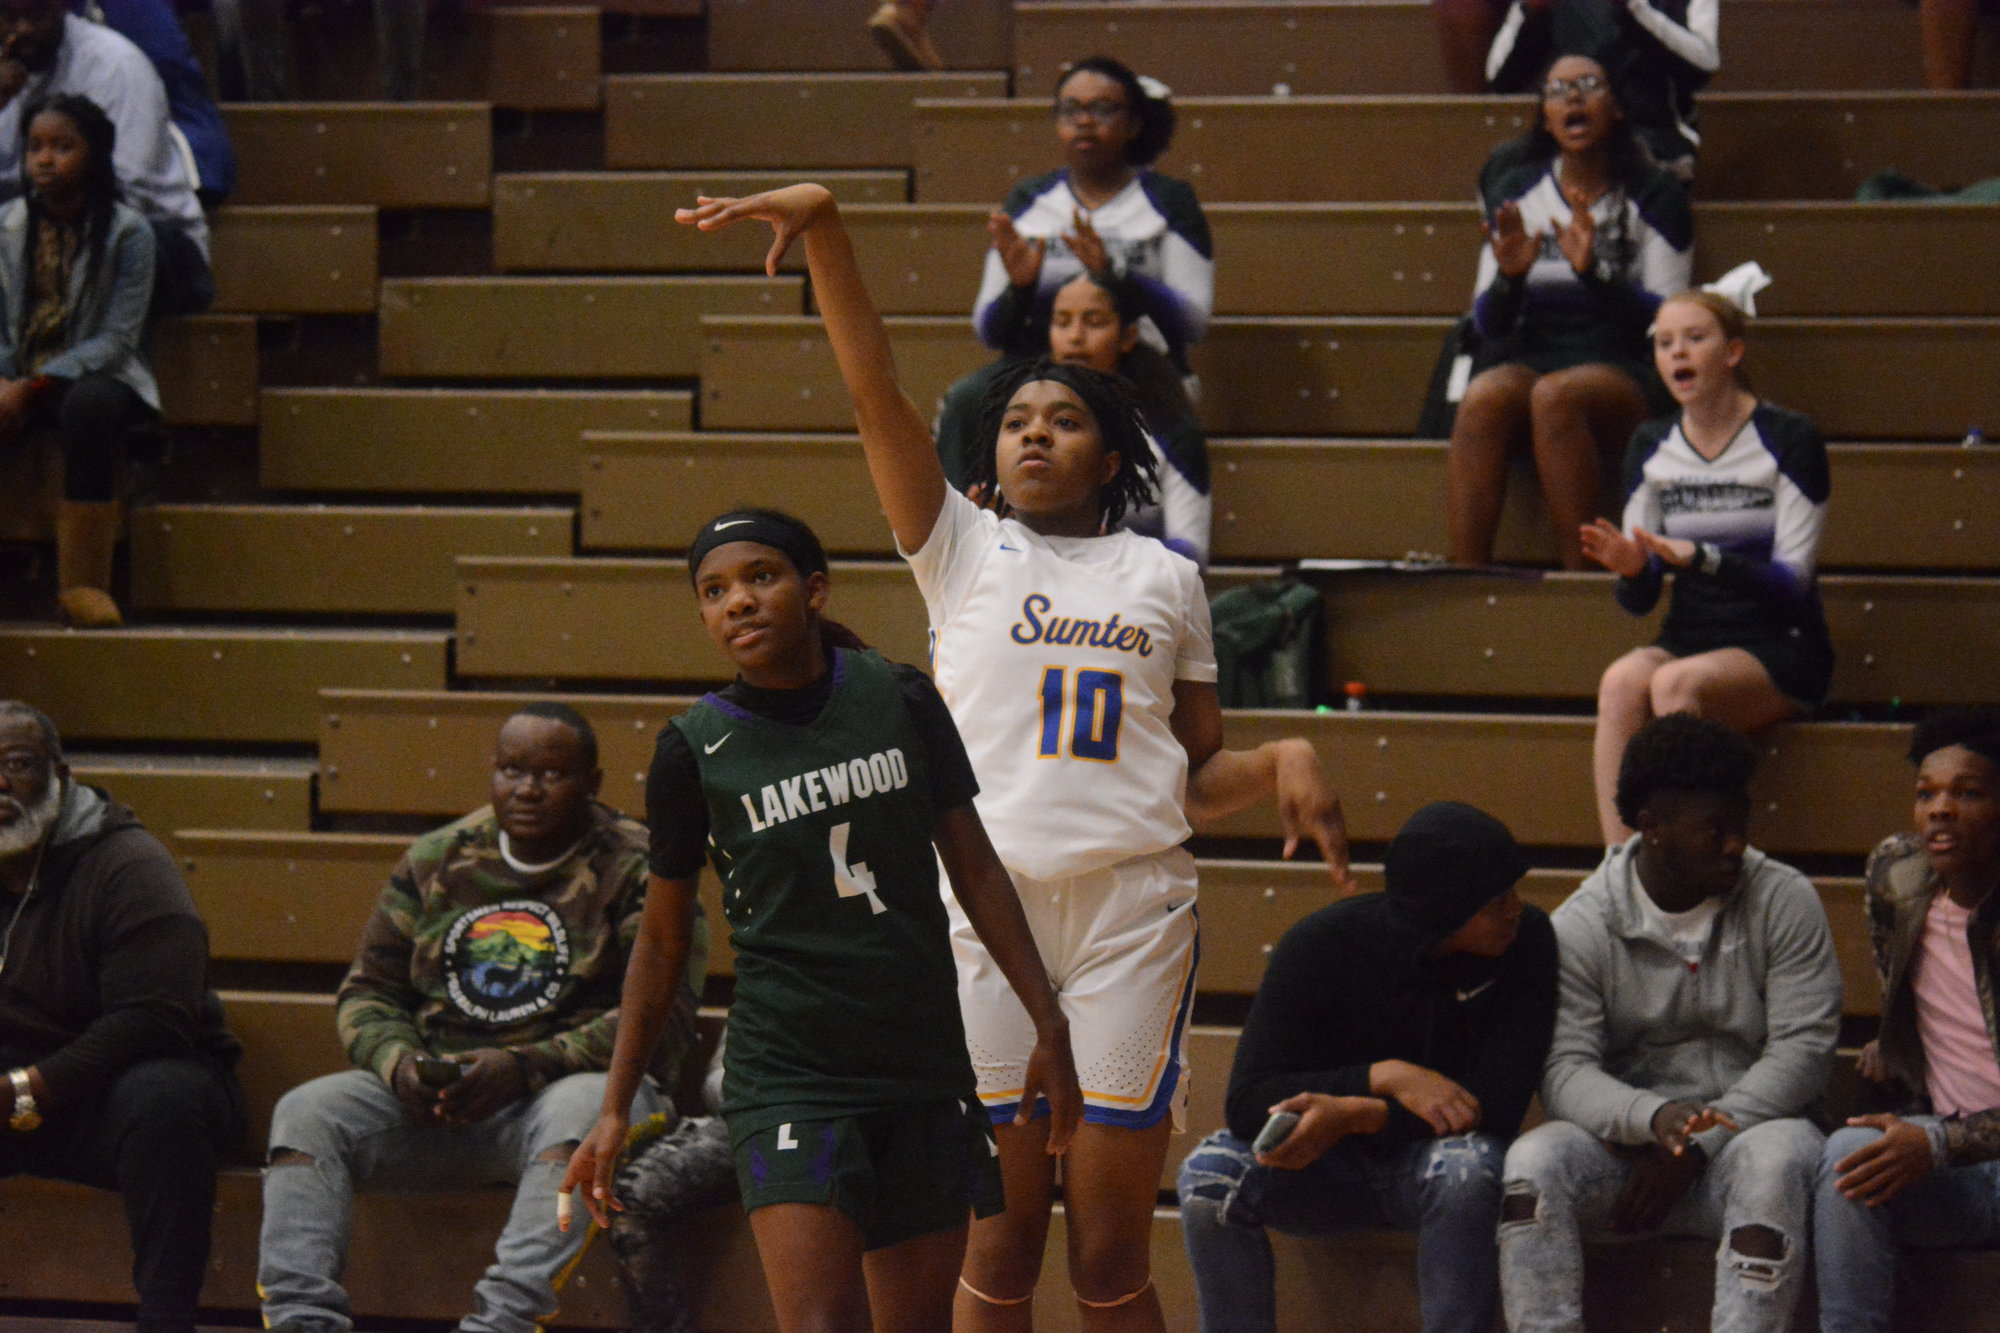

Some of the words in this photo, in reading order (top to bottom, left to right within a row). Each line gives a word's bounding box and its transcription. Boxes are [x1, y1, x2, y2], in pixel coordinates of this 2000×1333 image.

[1011, 592, 1153, 658] Sumter
[1037, 665, 1126, 764] 10
[740, 748, 909, 833] LAKEWOOD
[829, 821, 888, 915] 4
[777, 1123, 799, 1150] L
